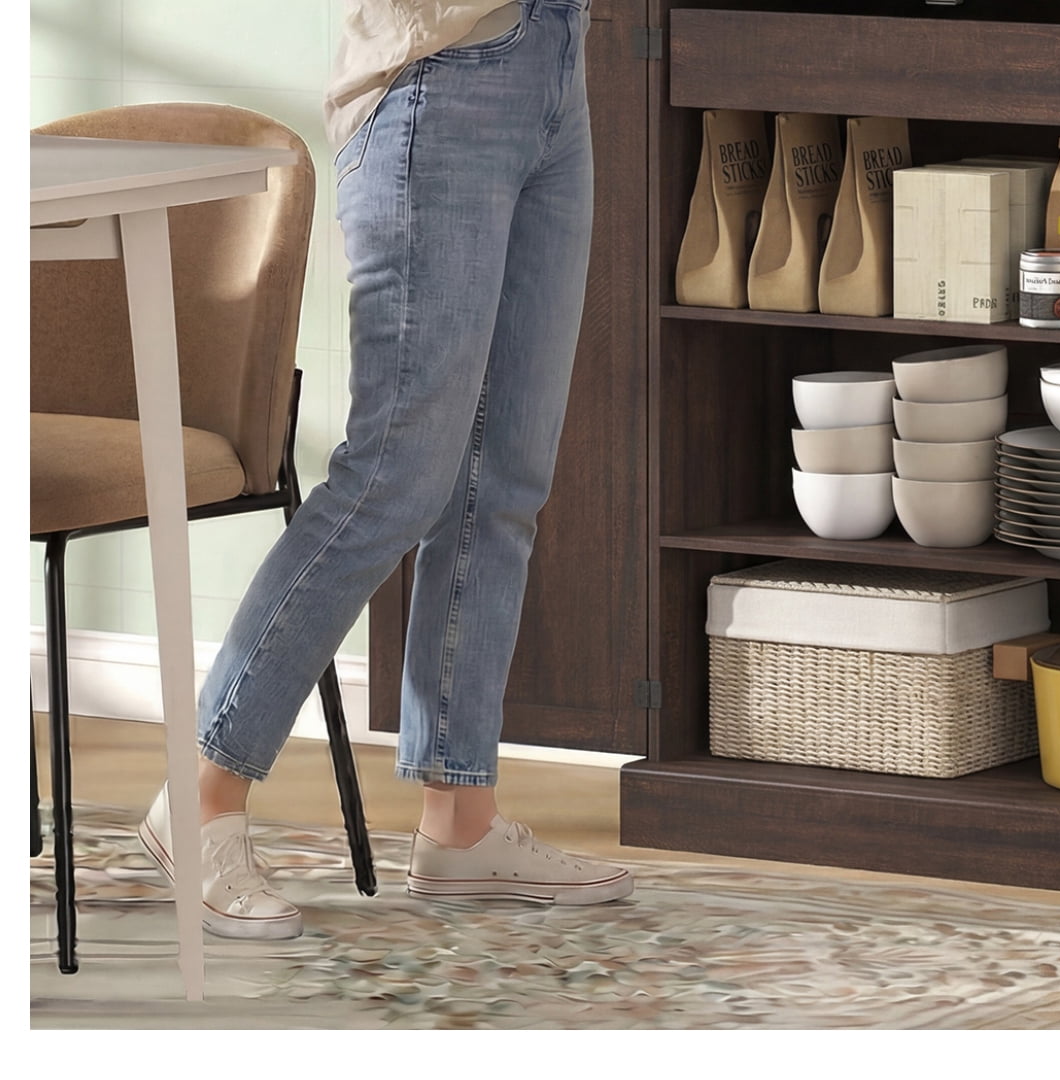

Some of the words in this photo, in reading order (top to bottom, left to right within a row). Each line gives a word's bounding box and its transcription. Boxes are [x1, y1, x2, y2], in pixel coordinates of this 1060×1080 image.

[719, 139, 761, 164] BREAD
[791, 142, 834, 167] BREAD
[862, 145, 903, 171] BREAD
[722, 160, 767, 185] STICKS
[794, 162, 839, 188] STICKS
